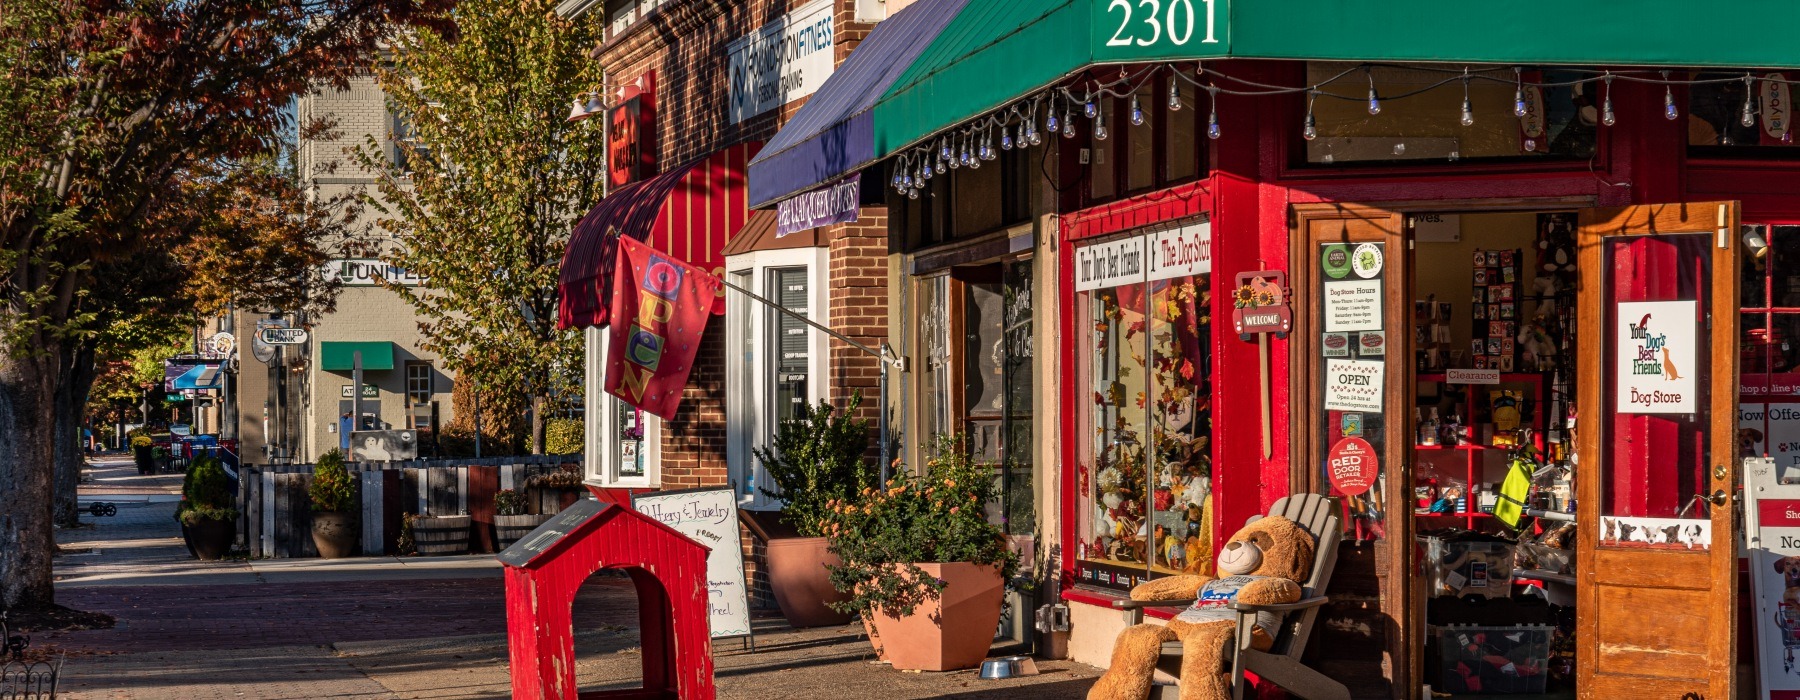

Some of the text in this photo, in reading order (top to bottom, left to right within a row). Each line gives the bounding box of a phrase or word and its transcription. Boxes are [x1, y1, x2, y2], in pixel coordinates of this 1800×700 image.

[1106, 0, 1219, 46] 2301
[781, 68, 803, 95] TRAINING
[1161, 233, 1211, 273] The Dog Stor
[1080, 241, 1140, 287] Your Dog's Best Friends
[1245, 314, 1278, 325] WELCOME
[1629, 323, 1666, 375] Your Dog's Best Friends
[1338, 374, 1371, 386] OPEN
[1448, 371, 1498, 380] Clearance
[1739, 385, 1759, 394] hop
[1761, 384, 1790, 393] oline
[1631, 390, 1682, 406] Dog Store
[1332, 455, 1362, 469] RED
[1334, 465, 1361, 475] DOOR
[1336, 472, 1361, 480] RETAILER
[689, 501, 729, 524] Jewelry
[709, 602, 734, 616] heel
